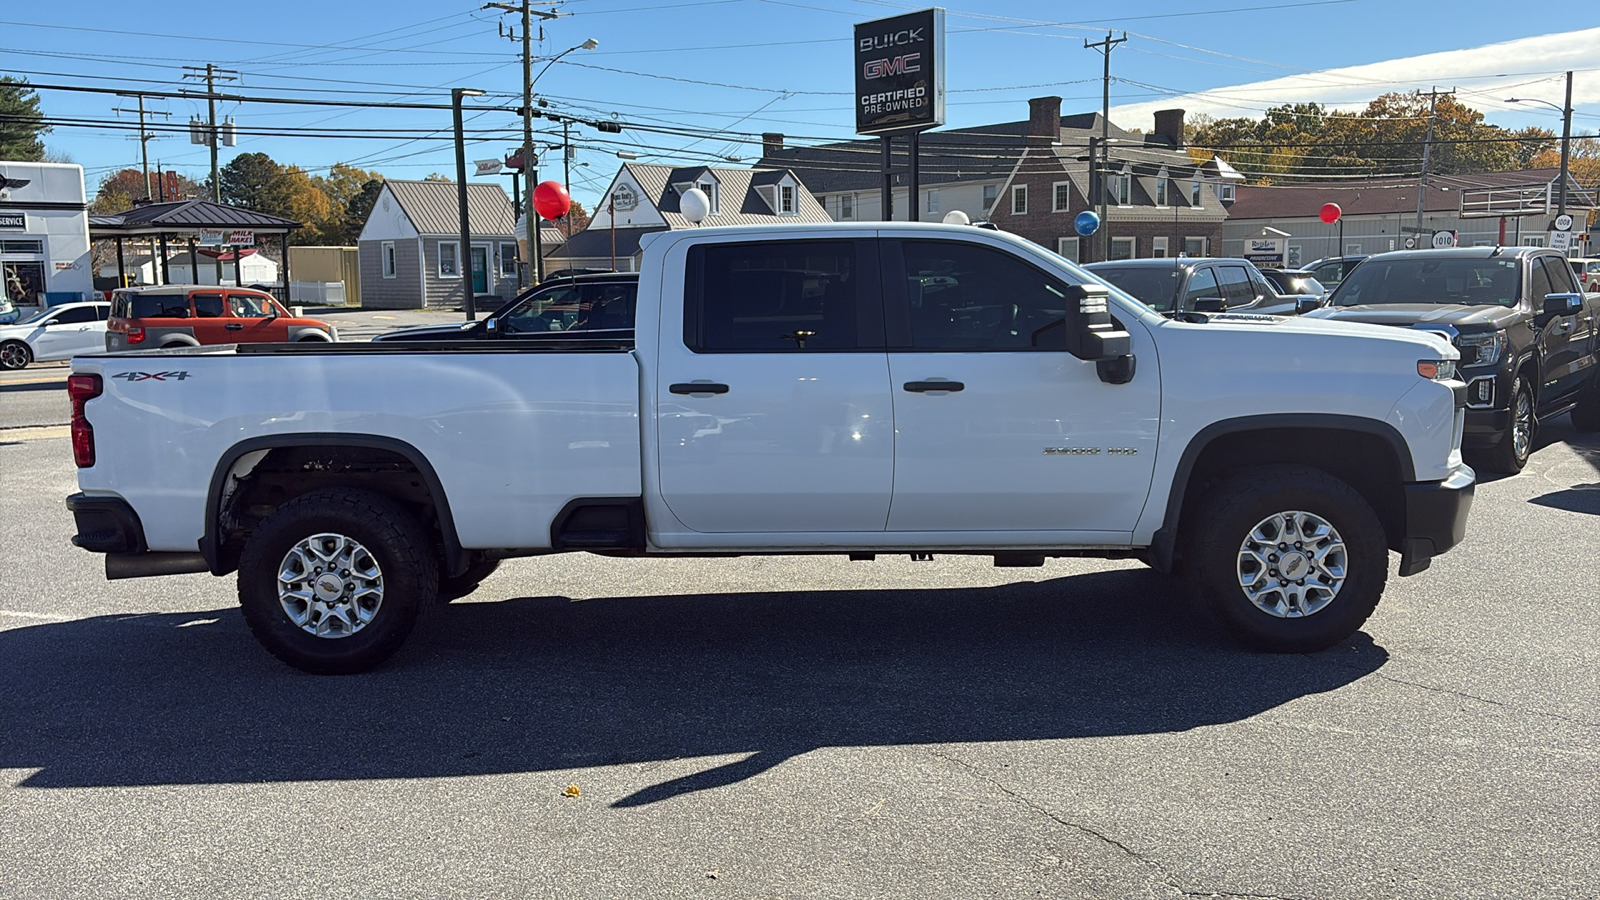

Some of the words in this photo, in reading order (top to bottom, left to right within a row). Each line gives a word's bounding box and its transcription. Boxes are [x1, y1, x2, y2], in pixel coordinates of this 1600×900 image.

[860, 27, 924, 52] BUICK
[864, 52, 920, 80] GMC
[861, 87, 925, 105] CERTIFIED
[864, 98, 922, 115] PRE-OWNED
[0, 217, 23, 226] SERVICE
[1435, 236, 1452, 245] 1010
[1042, 446, 1101, 456] 2500
[1107, 446, 1138, 456] HD
